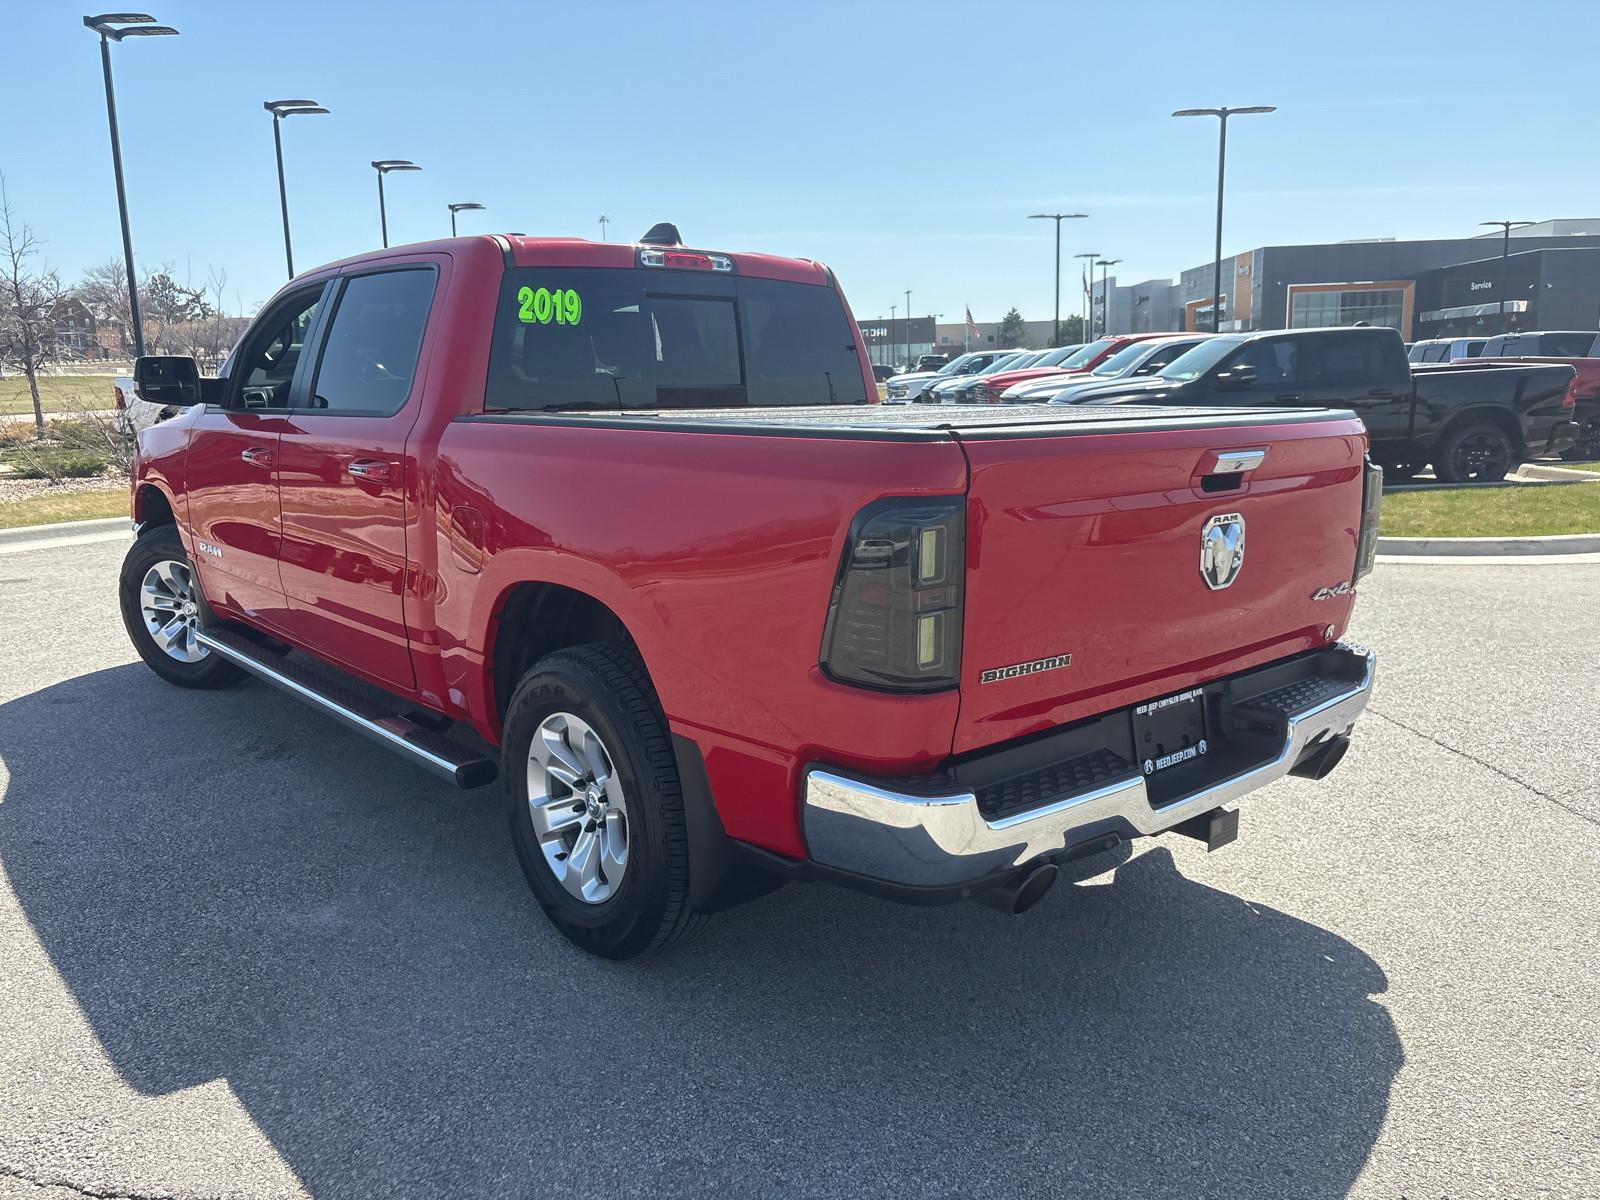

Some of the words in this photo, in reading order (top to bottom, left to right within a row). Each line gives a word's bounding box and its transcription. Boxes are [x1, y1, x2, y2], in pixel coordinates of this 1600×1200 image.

[1470, 280, 1493, 291] Service
[517, 286, 582, 326] 2019
[860, 327, 888, 338] NDAI
[1213, 514, 1239, 524] RAM
[199, 542, 223, 558] RAM
[1136, 705, 1147, 714] REED
[1148, 702, 1158, 711] JEEP
[1158, 696, 1179, 708] CHRYSLER
[1180, 691, 1192, 701] DODGE
[1193, 688, 1203, 696] RAM
[1156, 747, 1196, 770] REEDJEEP.COM
